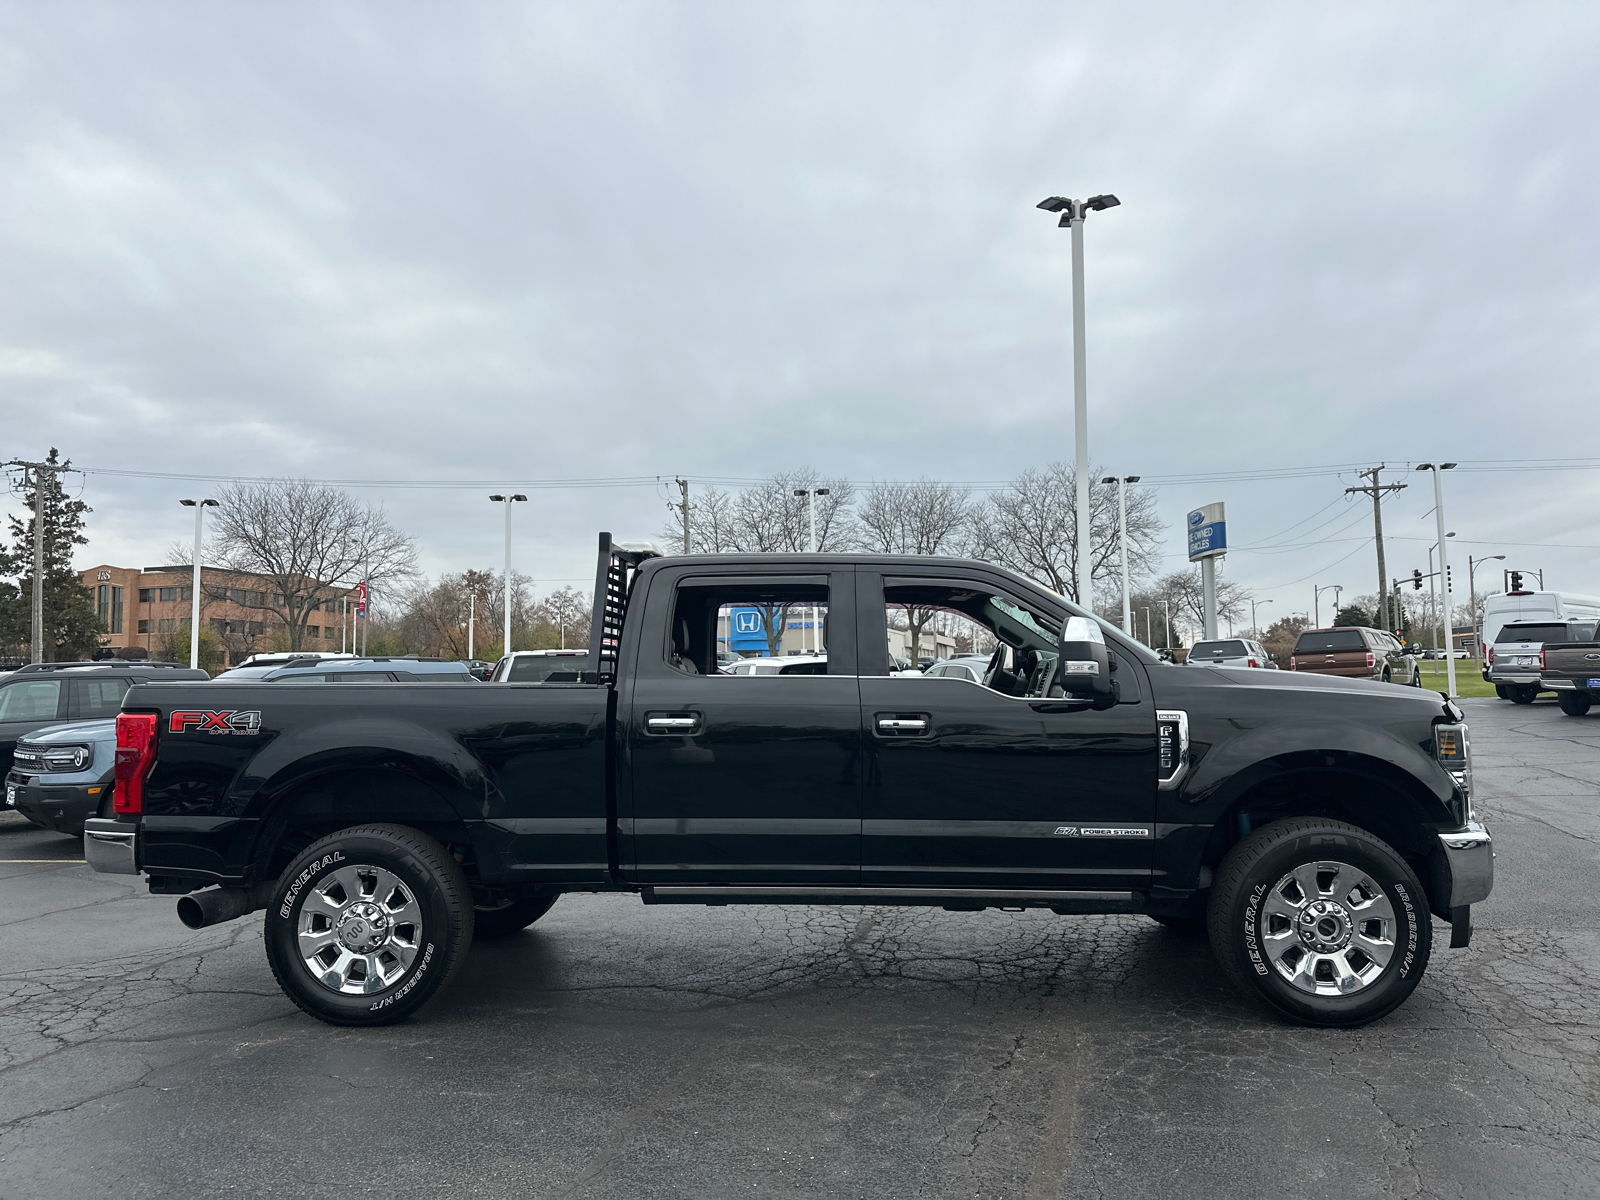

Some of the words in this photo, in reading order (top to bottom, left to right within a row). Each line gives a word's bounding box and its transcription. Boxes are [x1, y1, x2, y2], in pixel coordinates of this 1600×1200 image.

[169, 709, 261, 733] FX4
[280, 851, 346, 919] GENERAL
[1394, 883, 1418, 952] GRABBER
[1245, 884, 1269, 976] GENERAL
[395, 942, 435, 1001] GRABBER
